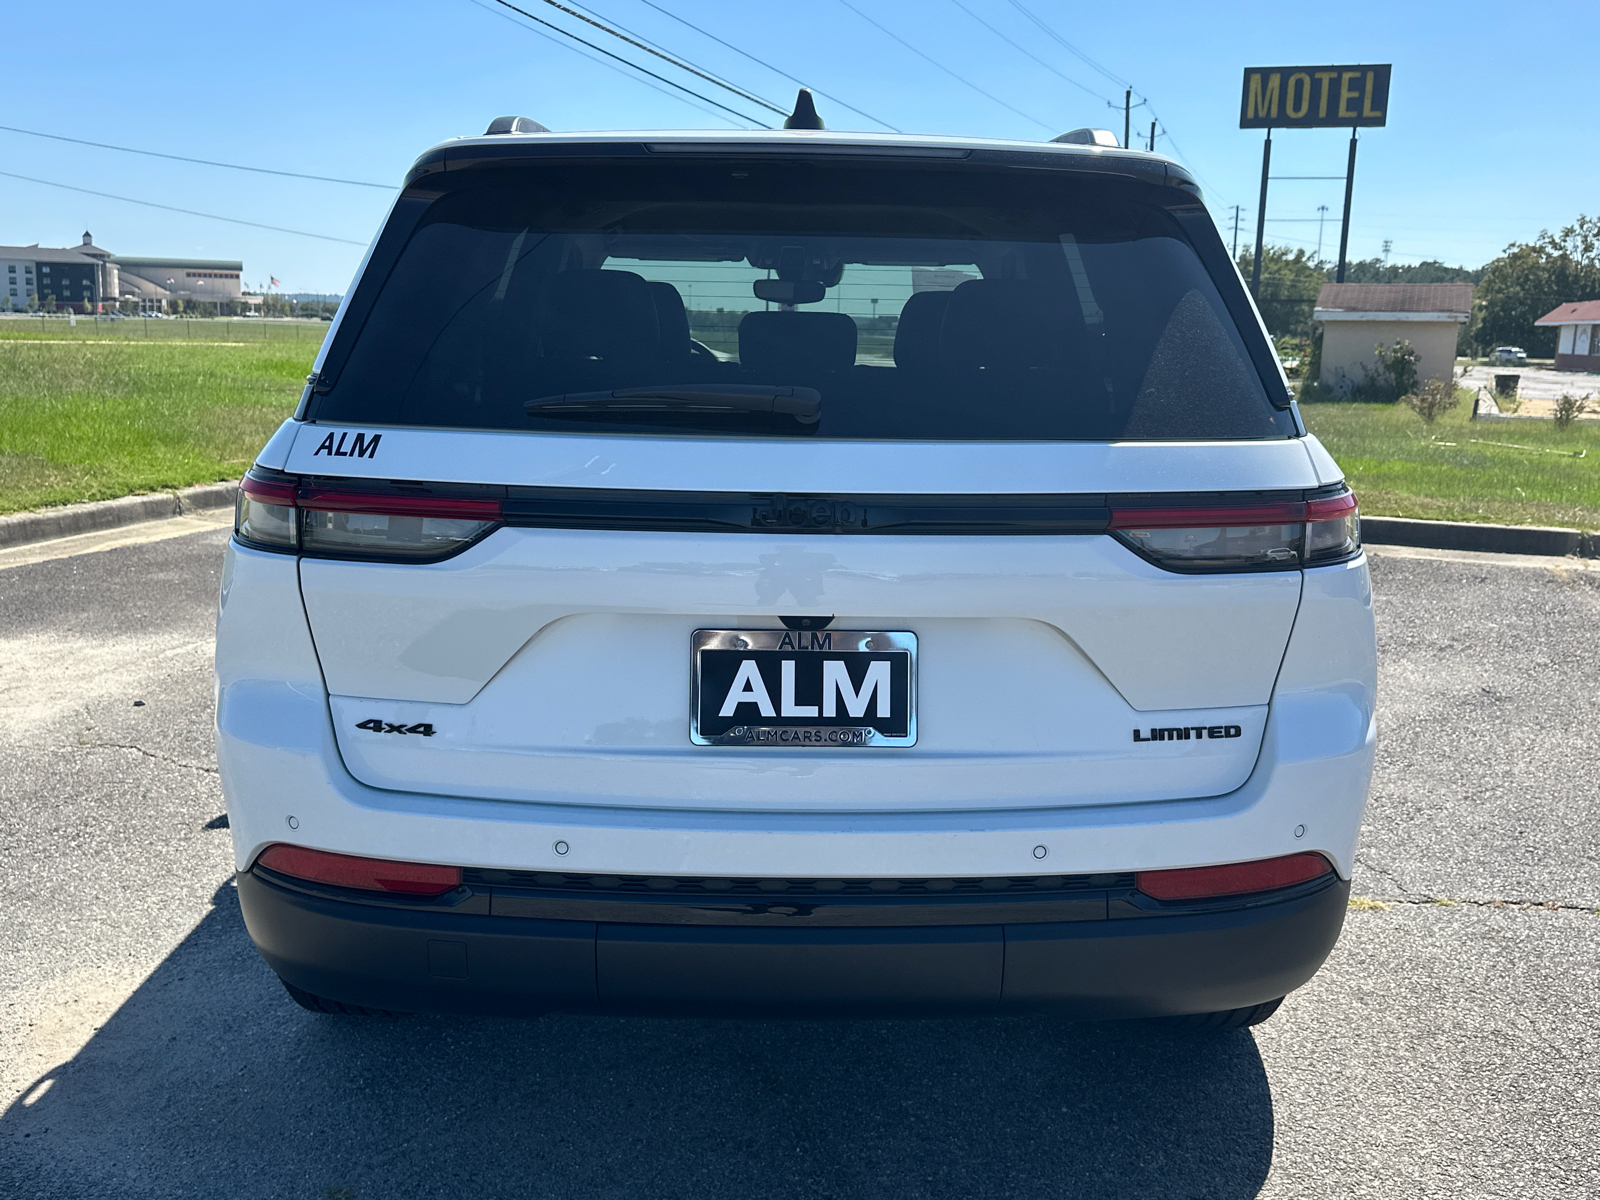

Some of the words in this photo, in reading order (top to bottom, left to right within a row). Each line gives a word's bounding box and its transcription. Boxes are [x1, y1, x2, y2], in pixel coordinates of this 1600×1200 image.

[1246, 71, 1382, 119] MOTEL
[313, 432, 382, 459] ALM
[758, 494, 857, 533] Jeep
[778, 632, 832, 650] ALM
[718, 659, 891, 718] ALM
[355, 718, 437, 737] 4x4
[745, 730, 864, 743] ALMCARS.COM
[1133, 725, 1242, 742] LIMITED
